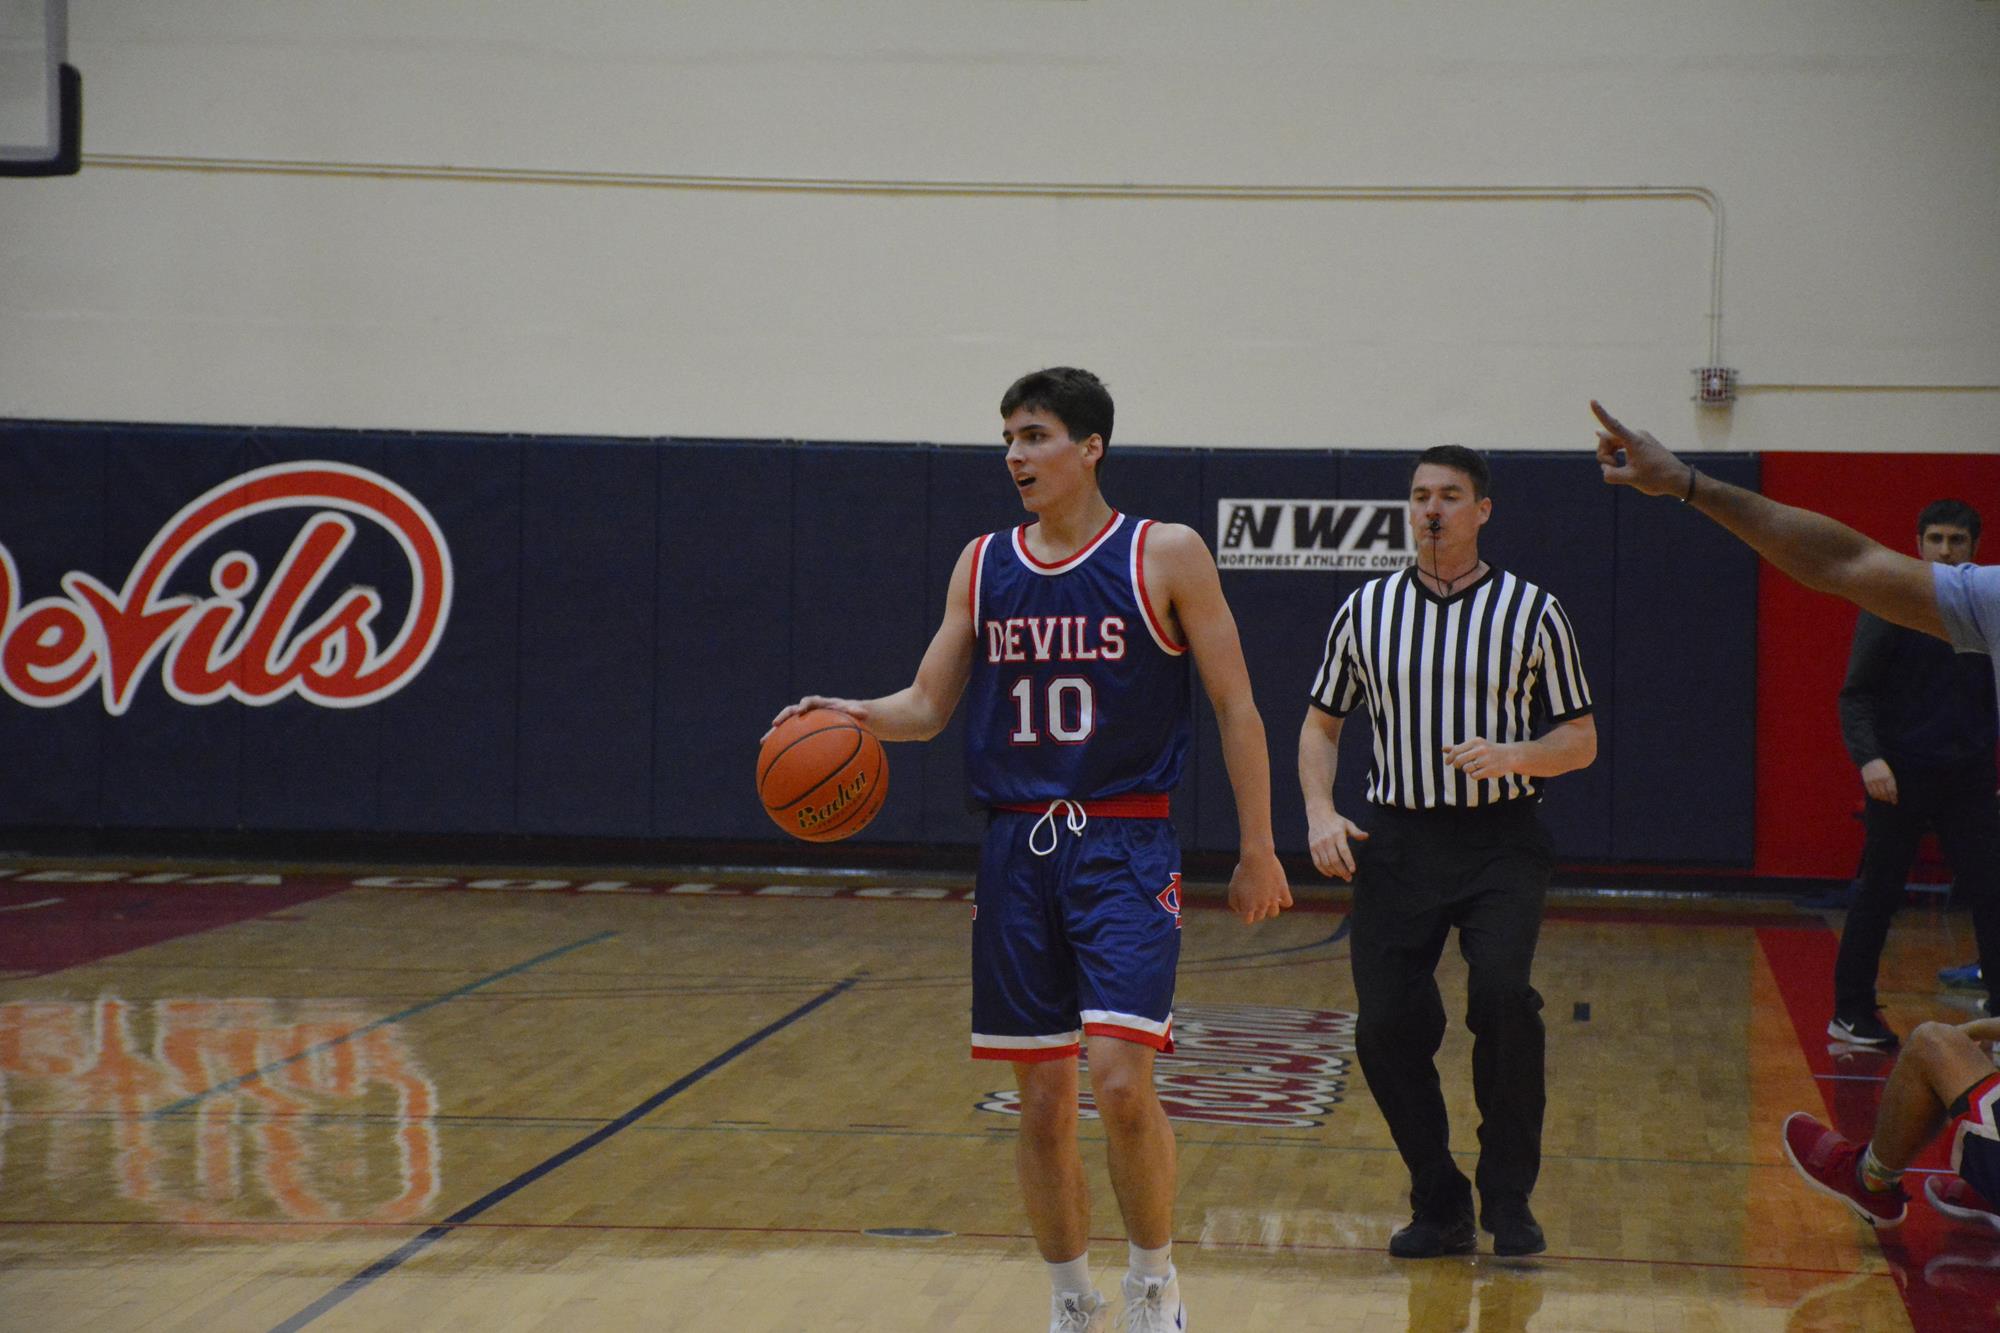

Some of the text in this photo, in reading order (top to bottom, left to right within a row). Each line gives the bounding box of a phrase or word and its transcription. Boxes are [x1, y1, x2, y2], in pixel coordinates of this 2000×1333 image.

[1223, 505, 1410, 550] NWA
[1219, 555, 1417, 568] NORTHWEST ATHLETIC CONFE
[0, 460, 453, 717] evils
[985, 615, 1127, 664] DEVILS
[1009, 675, 1096, 746] 10
[798, 771, 866, 828] Baden
[0, 870, 976, 900] BIA COLLEG
